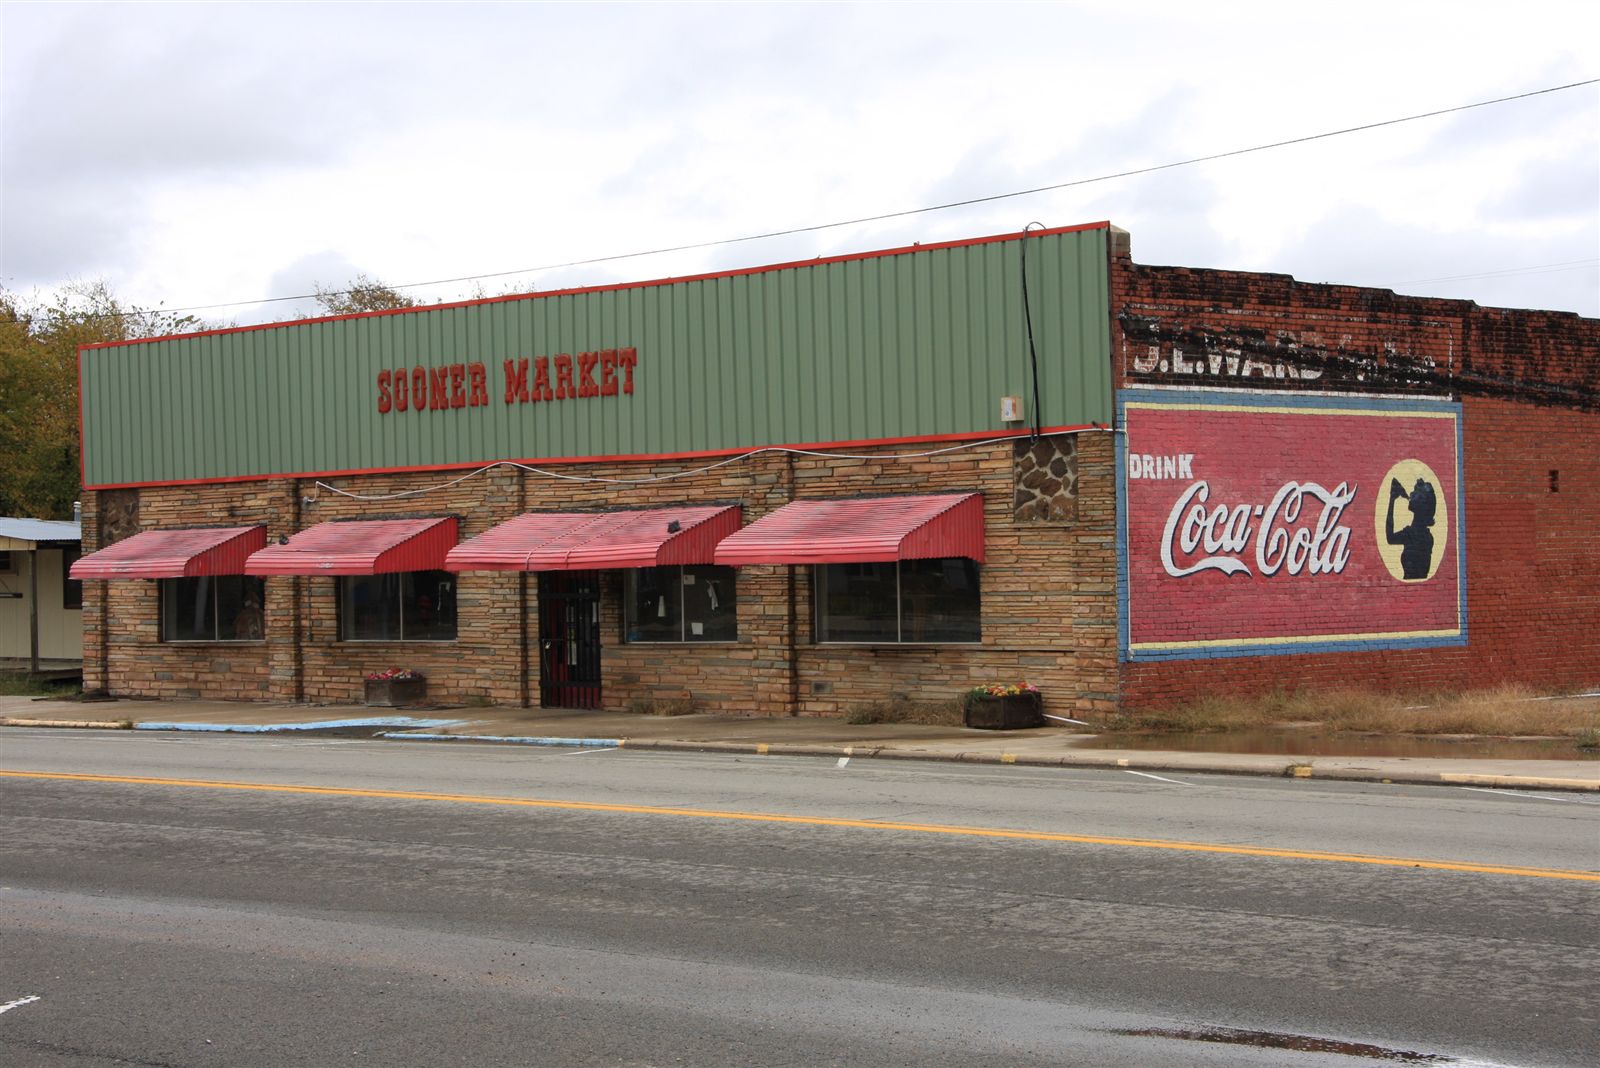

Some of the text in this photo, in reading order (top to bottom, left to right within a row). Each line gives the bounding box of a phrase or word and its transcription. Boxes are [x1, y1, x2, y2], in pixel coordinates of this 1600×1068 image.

[377, 347, 638, 414] SOONER MARKET
[1129, 454, 1194, 480] DRINK
[1160, 480, 1358, 578] Coca-Cola
